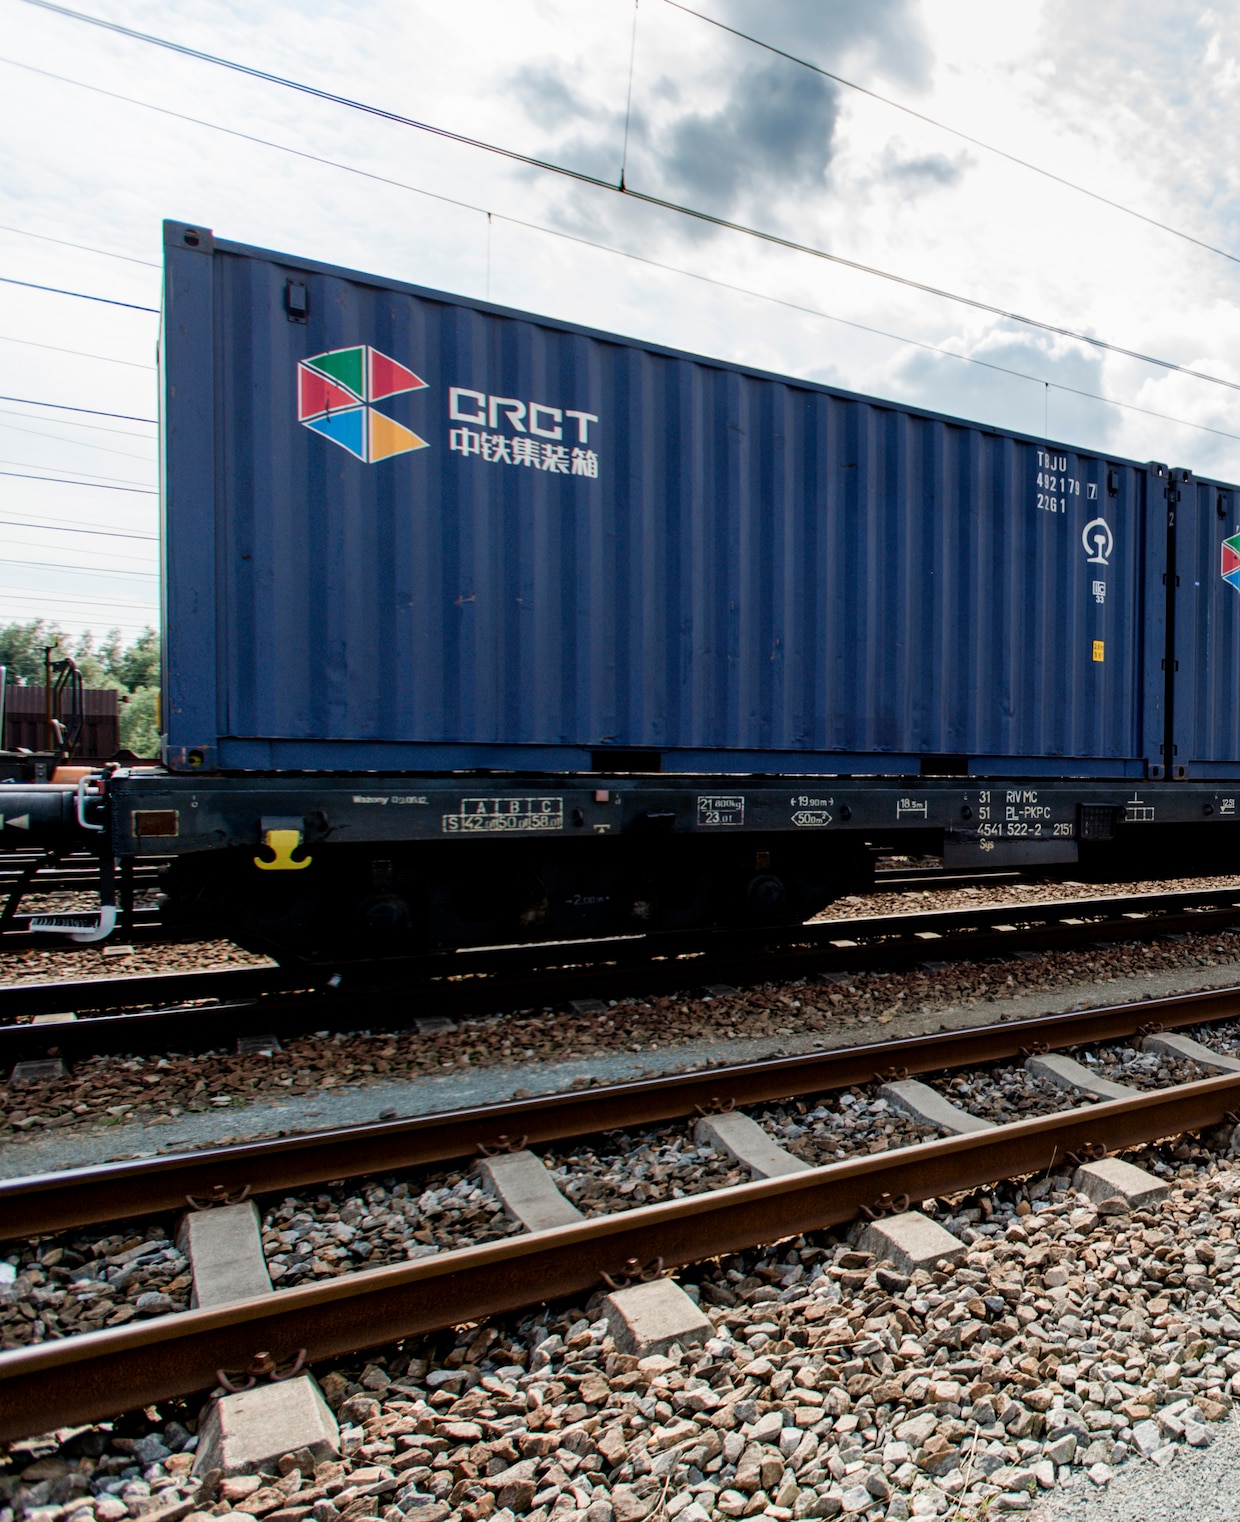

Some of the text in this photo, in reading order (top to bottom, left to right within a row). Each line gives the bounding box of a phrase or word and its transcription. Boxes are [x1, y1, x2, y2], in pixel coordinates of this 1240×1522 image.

[449, 386, 599, 444] CRCT
[449, 427, 599, 478] 中铁集装箱
[1037, 451, 1066, 473] TBJU
[1037, 493, 1066, 514] 22G1
[979, 791, 991, 803] 31
[1006, 791, 1022, 803] RIV
[1023, 791, 1038, 803] MC
[476, 800, 552, 814] A B C
[979, 807, 1051, 820] 51 PL-PKPC
[448, 817, 459, 829] S
[977, 823, 1074, 836] 4541 522-2 2151
